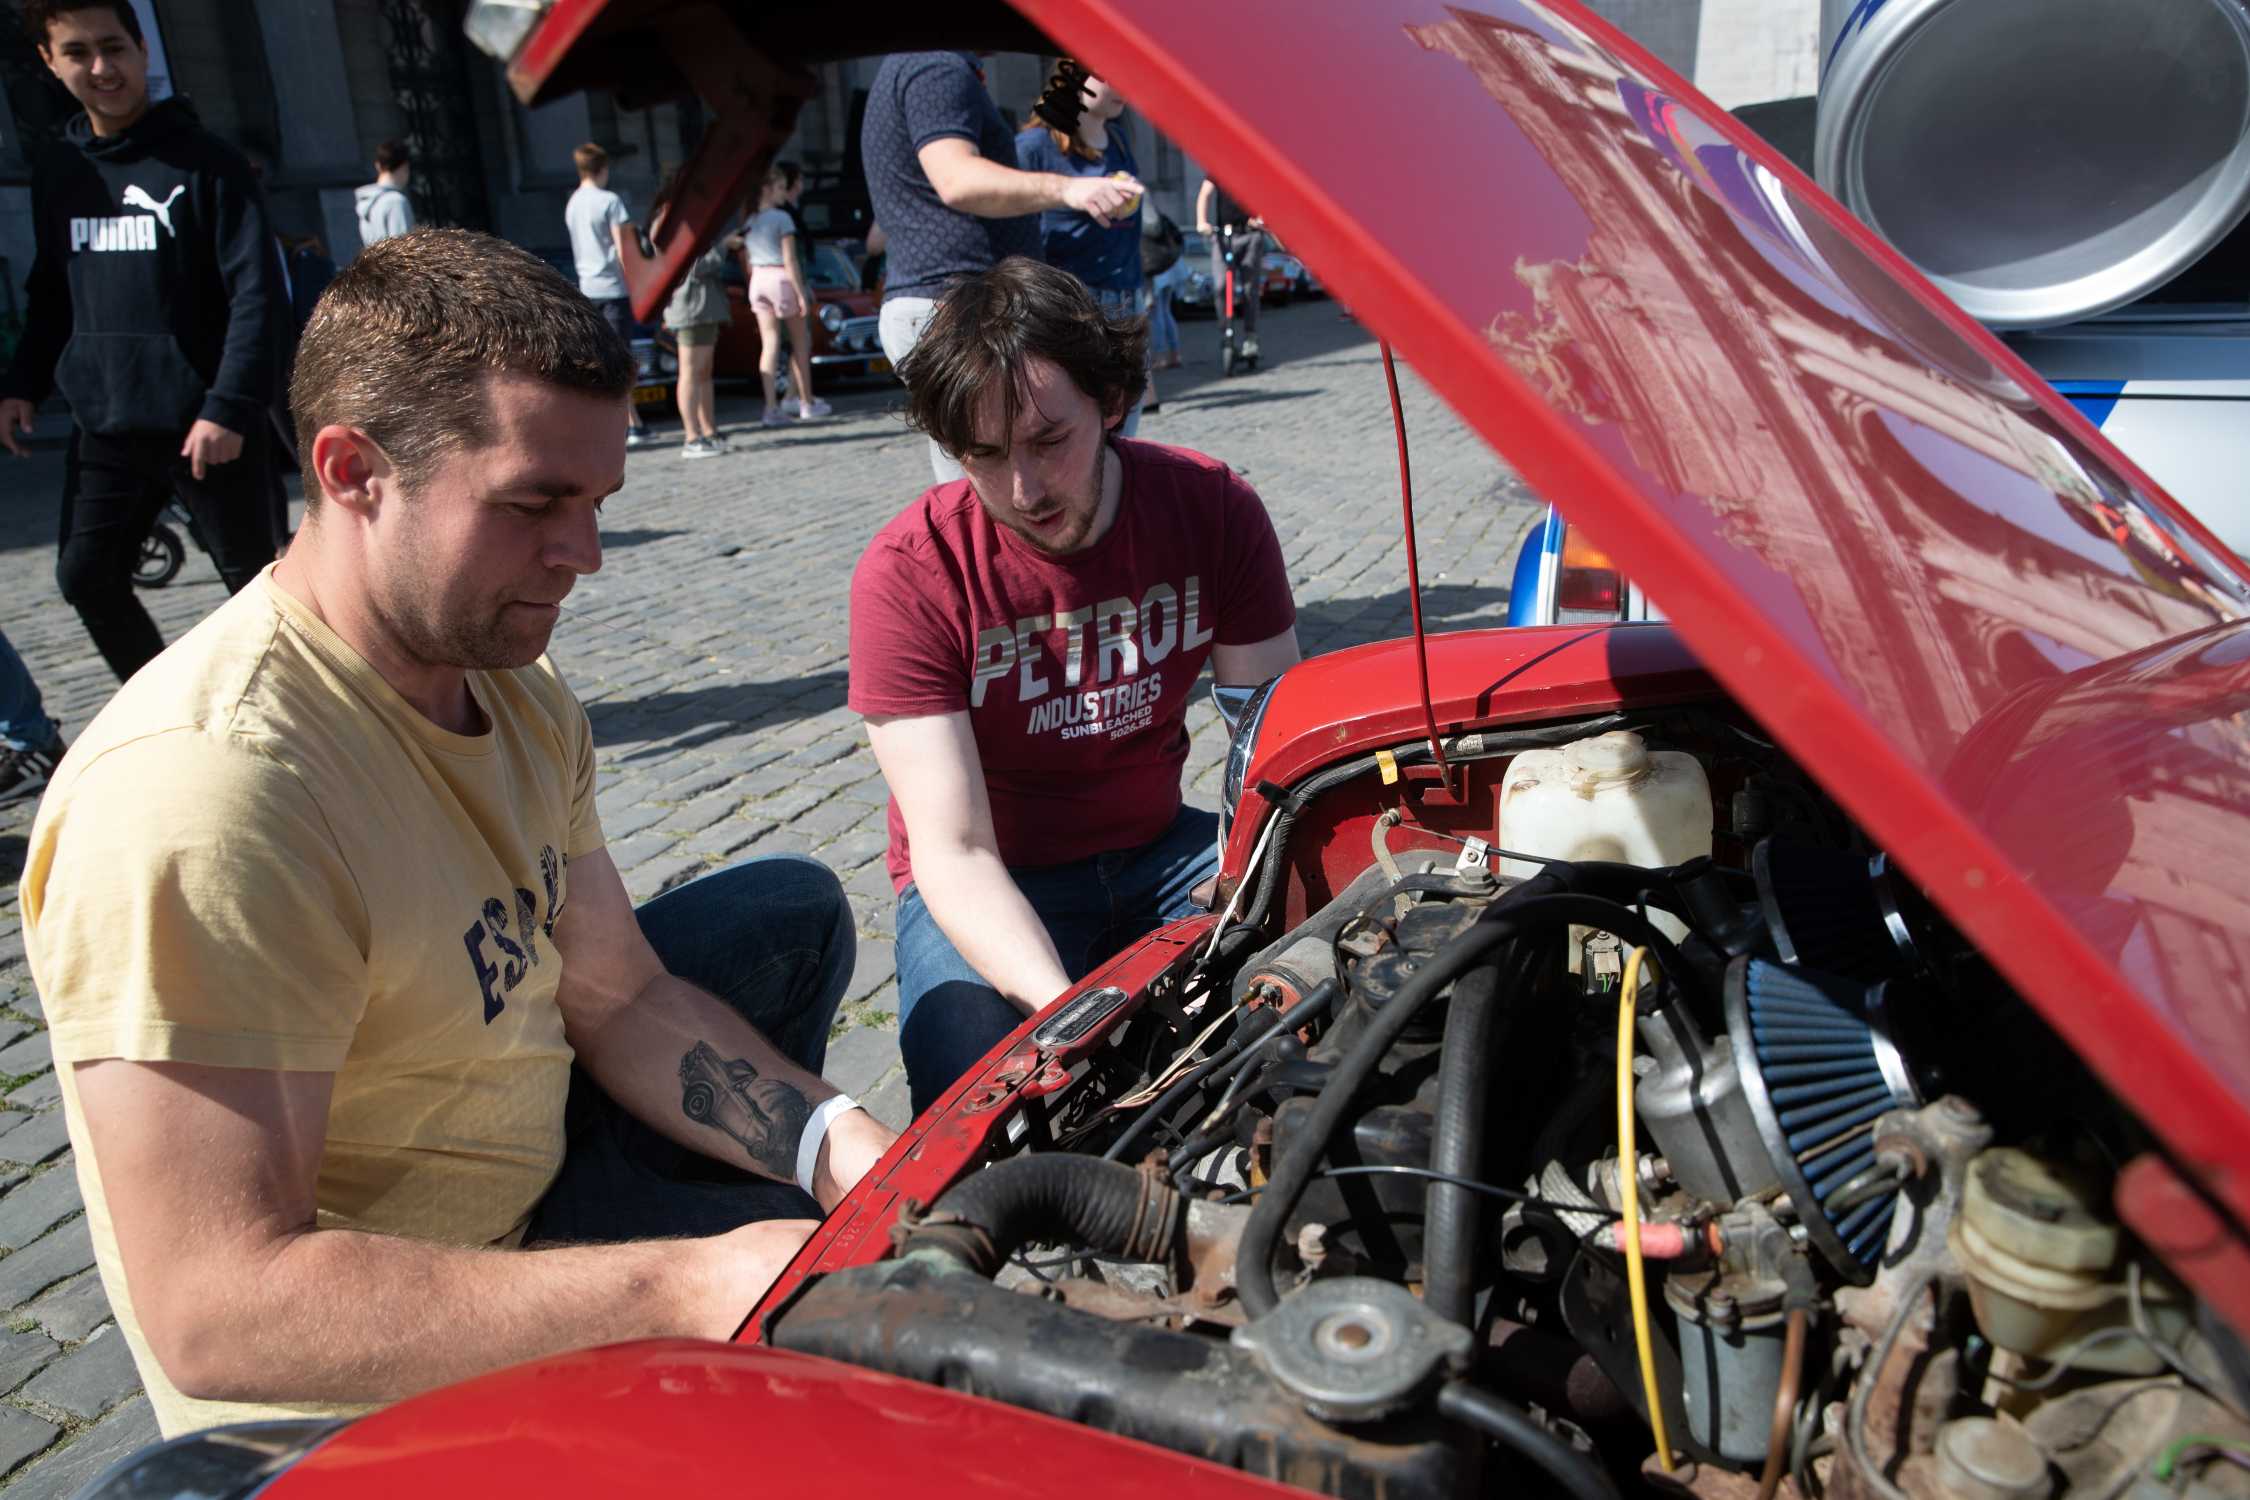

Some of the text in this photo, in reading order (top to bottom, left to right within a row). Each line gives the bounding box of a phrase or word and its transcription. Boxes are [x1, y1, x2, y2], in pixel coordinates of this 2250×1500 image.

[70, 215, 157, 252] PUMA
[970, 576, 1213, 707] PETROL
[1027, 672, 1162, 735] INDUSTRIES
[1060, 705, 1153, 740] SUNBLEACHED
